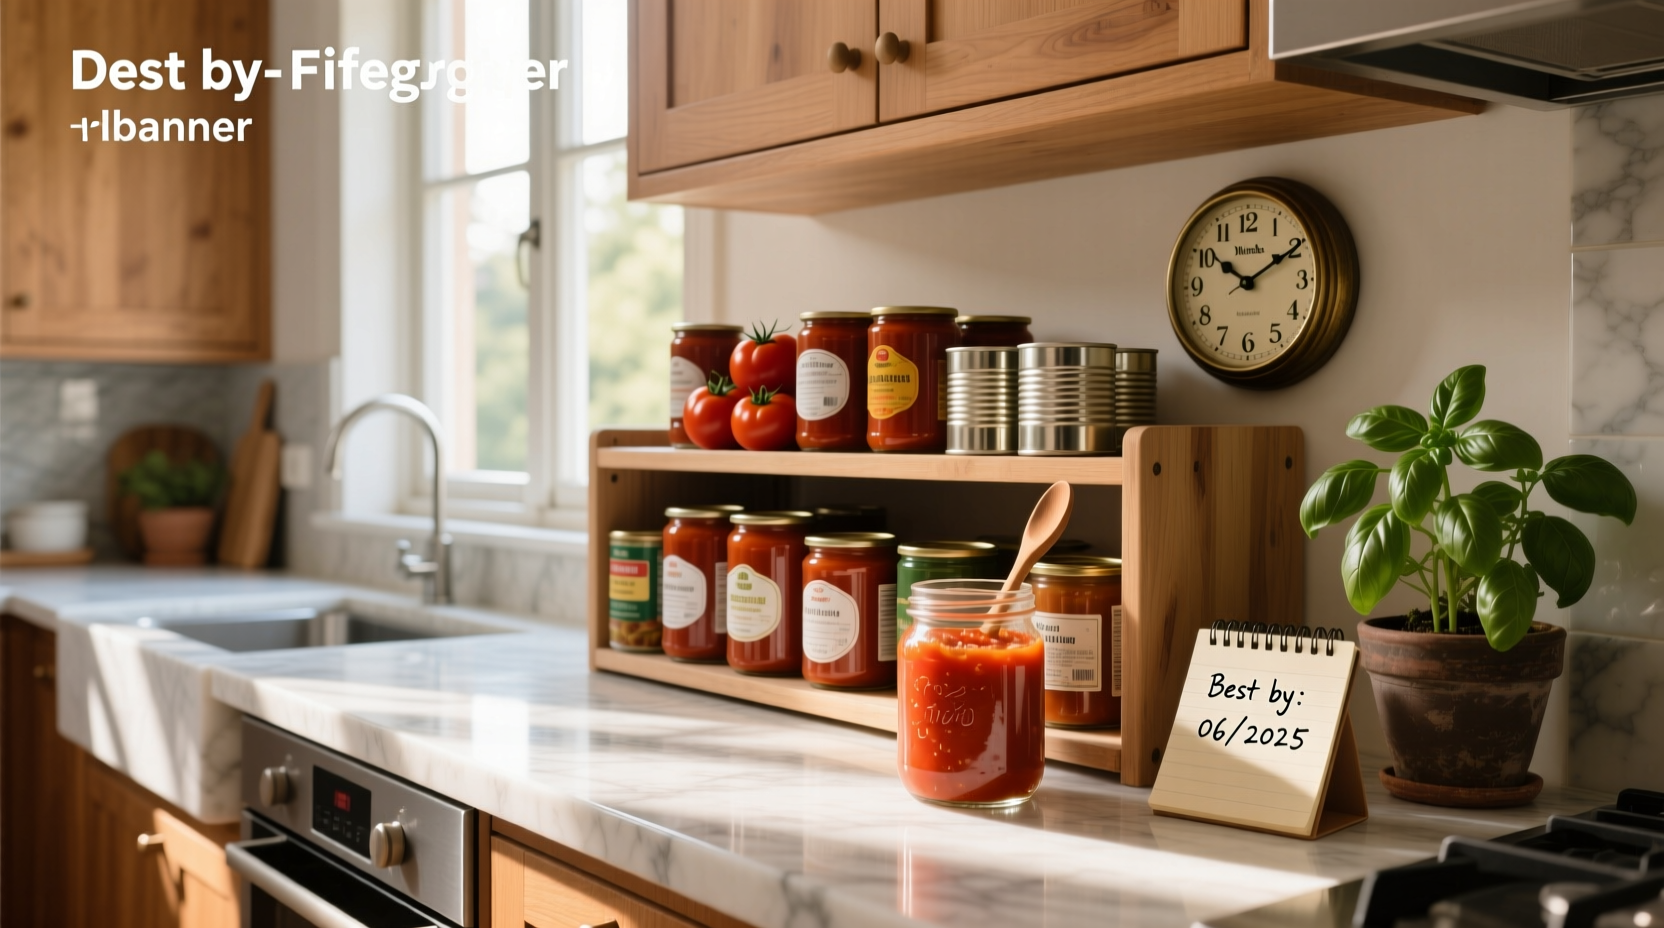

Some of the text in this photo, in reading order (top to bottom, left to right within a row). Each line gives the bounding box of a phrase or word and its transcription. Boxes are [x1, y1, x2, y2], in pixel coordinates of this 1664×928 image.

[1217, 223, 1230, 242] 11
[1239, 212, 1258, 233] 12
[1272, 217, 1278, 237] 1
[1199, 248, 1216, 268] 10
[1288, 237, 1302, 259] 2
[1191, 276, 1204, 297] 9
[1296, 269, 1308, 290] 3
[1199, 305, 1212, 326] 8
[1287, 299, 1299, 321] 4
[1216, 325, 1229, 346] 7
[1241, 332, 1255, 353] 6
[1269, 323, 1282, 344] 5
[1207, 672, 1305, 717] Best by:
[1198, 715, 1310, 751] 06/2025
